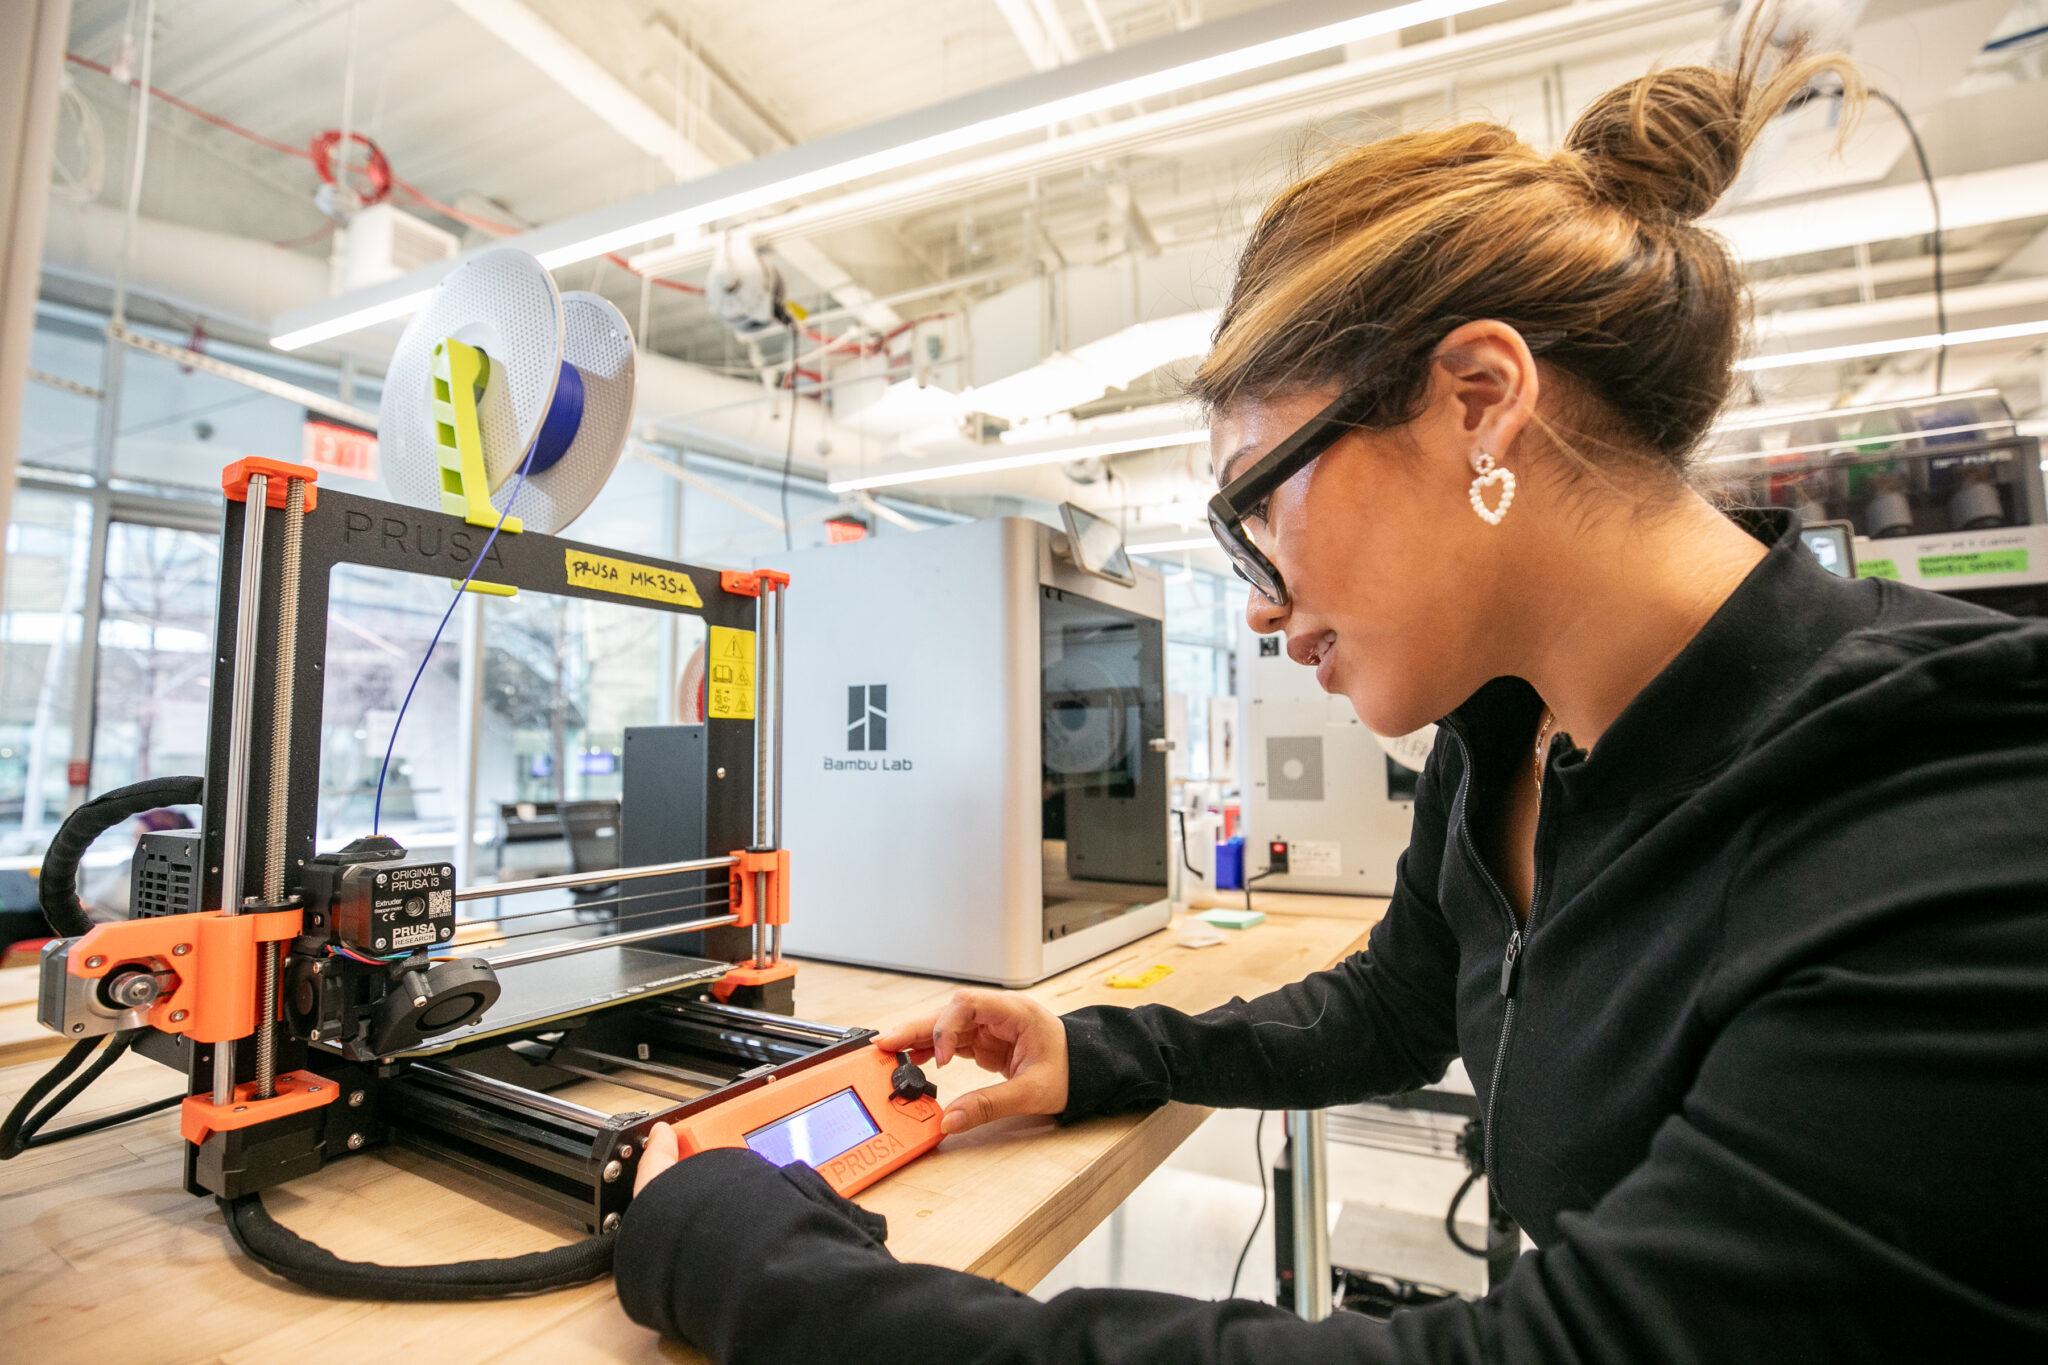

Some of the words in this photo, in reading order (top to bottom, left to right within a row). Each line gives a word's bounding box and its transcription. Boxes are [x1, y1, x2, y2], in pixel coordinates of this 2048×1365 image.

[344, 509, 504, 570] PRUSA
[572, 560, 619, 580] PRUSA
[630, 572, 687, 594] MK3S+
[823, 756, 878, 771] Bambu
[882, 758, 913, 771] Lab
[391, 868, 438, 880] ORIGINAL
[391, 879, 429, 891] PRUSA
[430, 877, 440, 888] i3
[375, 899, 402, 907] Extruder
[393, 923, 435, 937] PRUSA
[395, 935, 434, 946] RESEARCH
[831, 1132, 905, 1184] PRUSA
